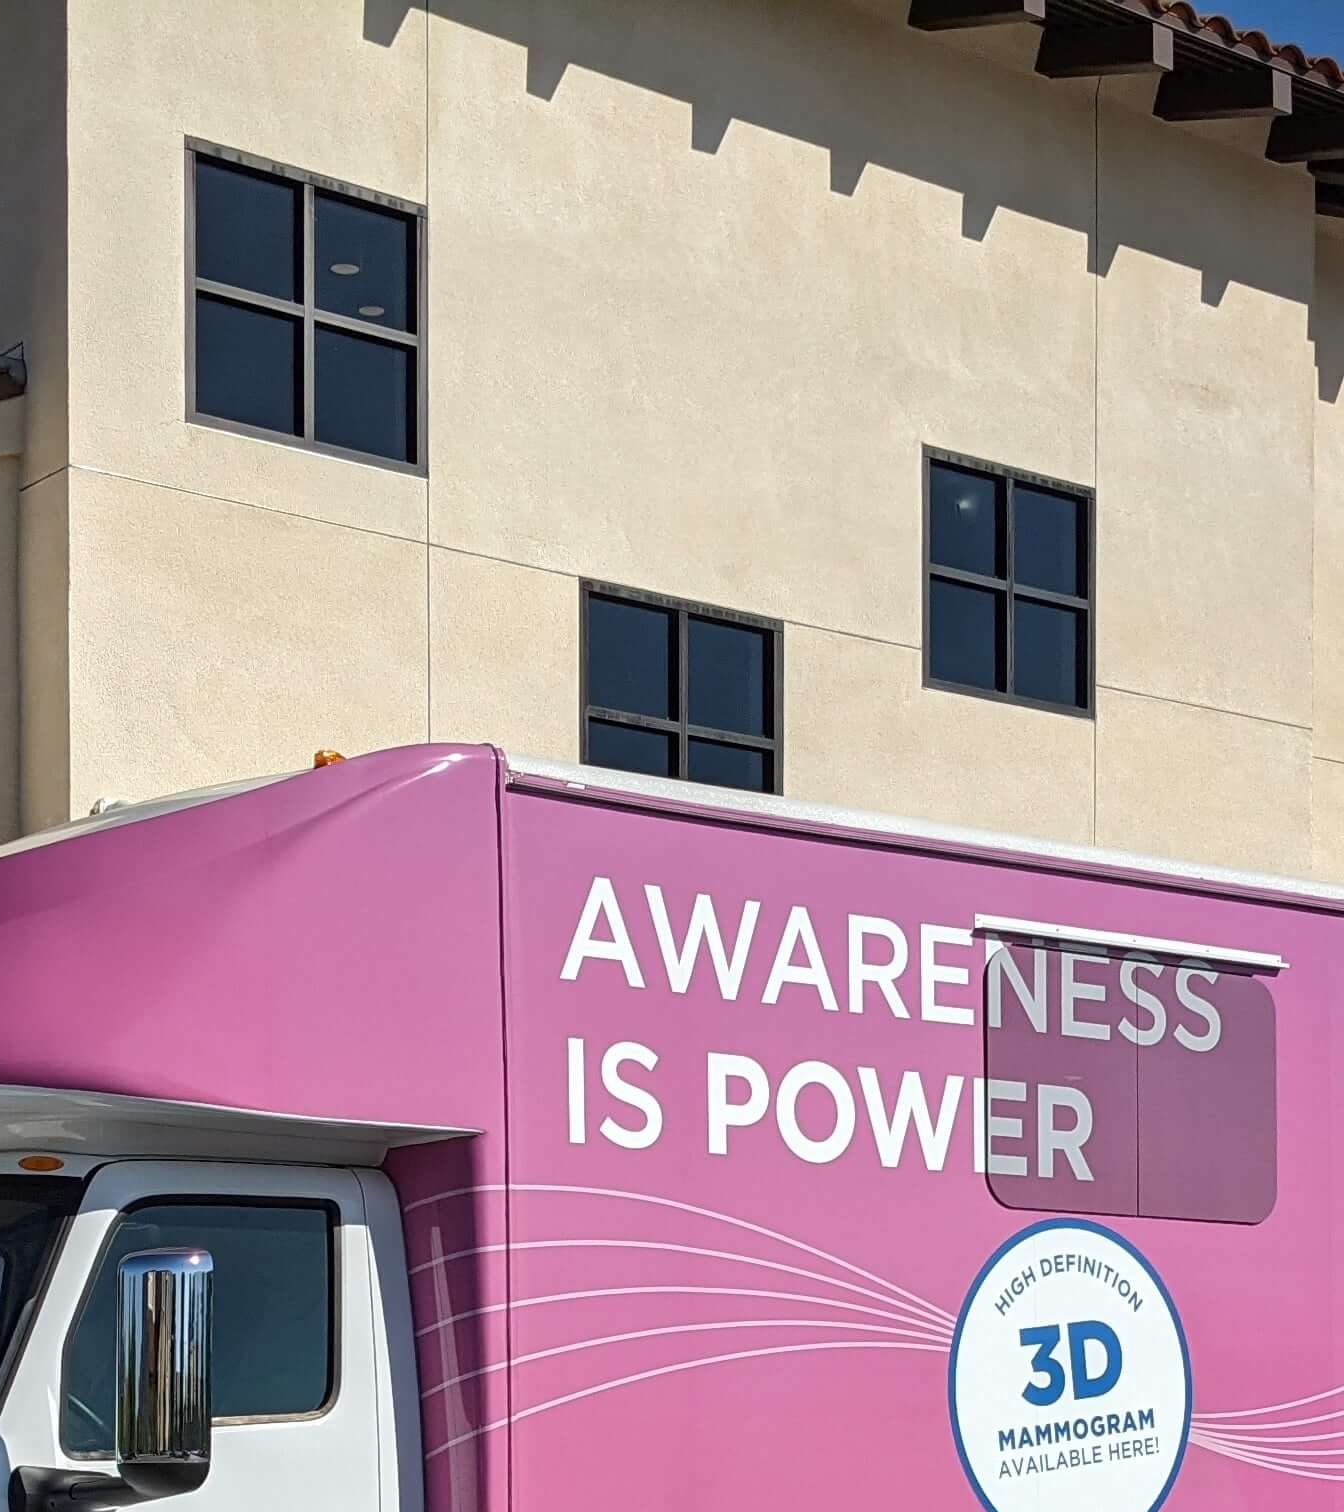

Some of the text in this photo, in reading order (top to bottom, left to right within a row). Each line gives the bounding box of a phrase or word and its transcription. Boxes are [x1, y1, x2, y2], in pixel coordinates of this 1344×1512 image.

[559, 876, 1223, 1053] AWARENESS
[567, 1037, 1096, 1183] IS POWER
[994, 1254, 1144, 1316] HIGH DEFINITION
[1018, 1320, 1123, 1407] 3D
[997, 1408, 1156, 1451] MAMMOGRAM
[998, 1437, 1161, 1480] AVAILABLE HERE!
